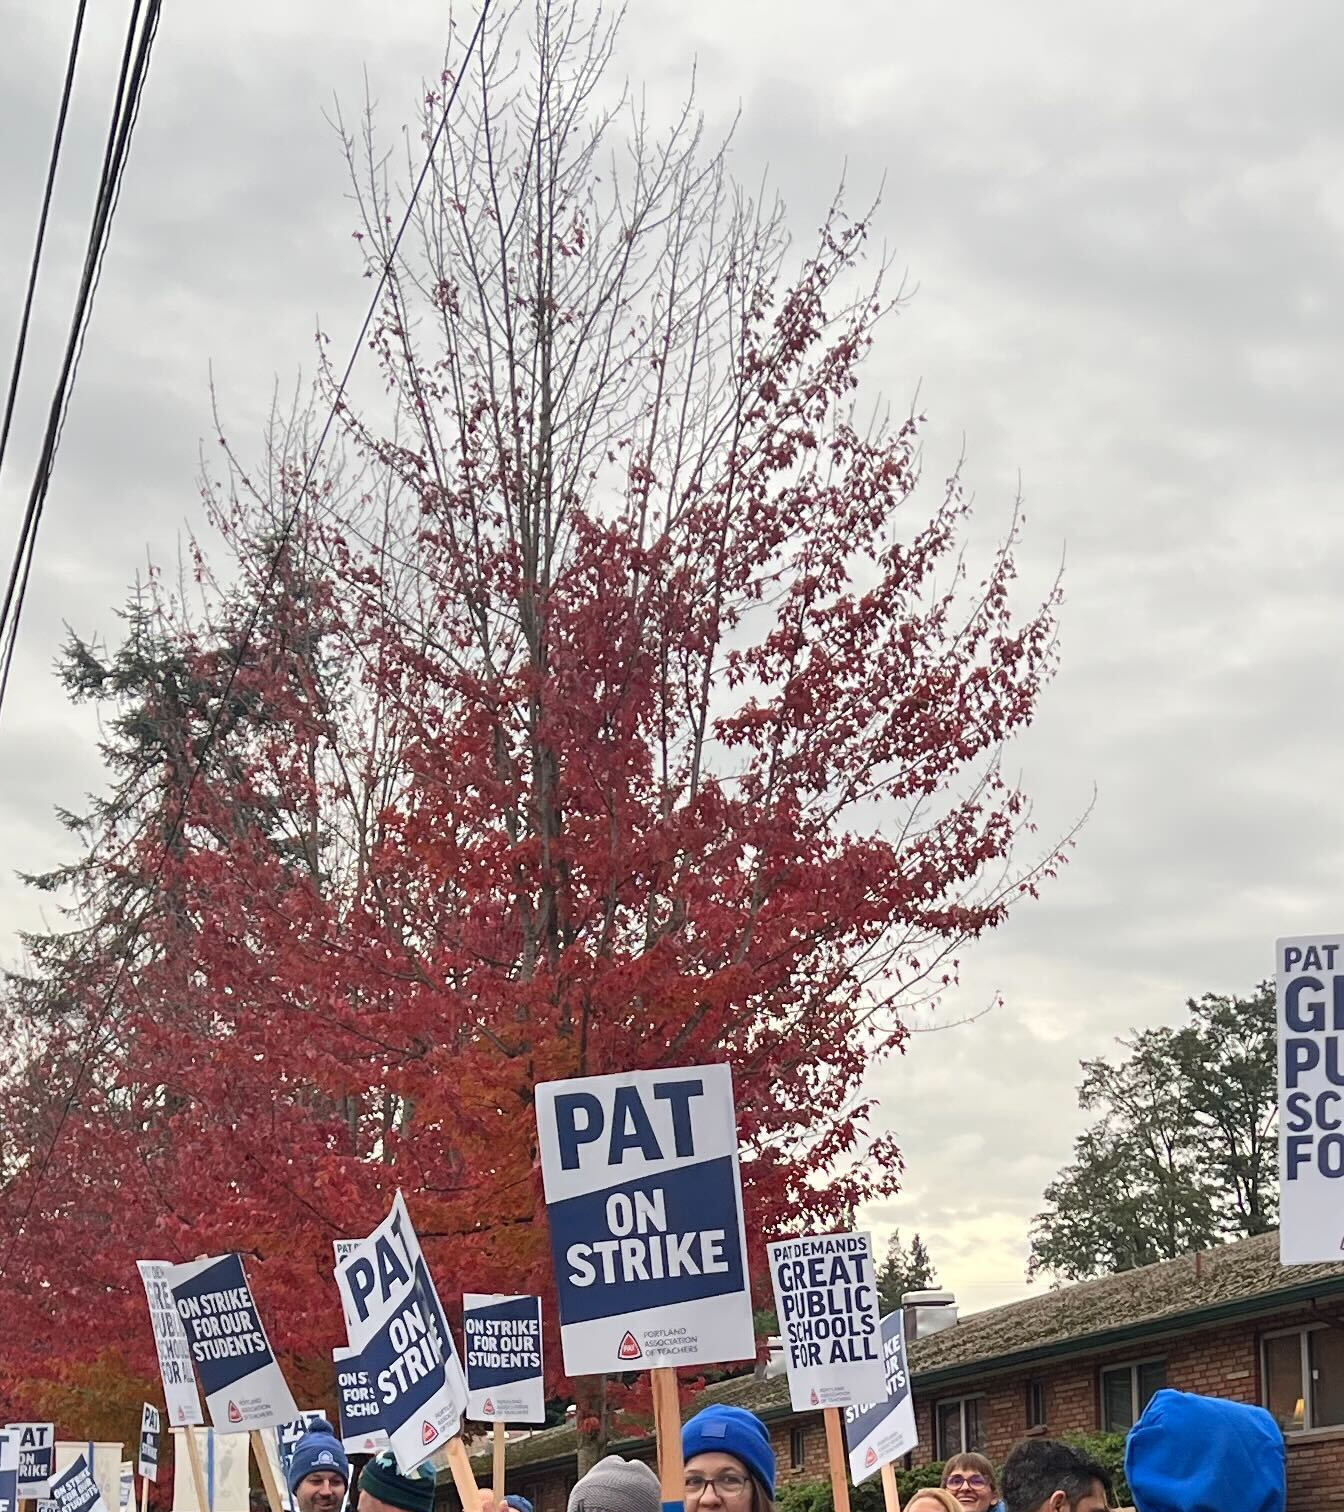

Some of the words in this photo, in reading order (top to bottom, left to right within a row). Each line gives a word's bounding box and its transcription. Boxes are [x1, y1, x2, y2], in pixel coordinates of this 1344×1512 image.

[1285, 944, 1339, 972] PAT
[554, 1079, 704, 1171] PAT
[606, 1188, 668, 1237] ON
[566, 1229, 729, 1287] STRIKE
[774, 1246, 794, 1262] PAT
[794, 1237, 867, 1258] DEMANDS
[345, 1209, 414, 1323] PAT
[777, 1253, 868, 1292] GREAT
[177, 1297, 201, 1319] ON
[200, 1287, 252, 1315] STRIKE
[781, 1285, 873, 1321] PUBLIC
[192, 1317, 222, 1340] FOR
[221, 1310, 254, 1334] OUR
[389, 1301, 426, 1353] ON
[466, 1319, 484, 1335] ON
[485, 1319, 539, 1336] STRIKE
[644, 1328, 687, 1338] PORTLAND
[787, 1314, 875, 1344] SCHOOLS
[193, 1332, 266, 1362] STUDENTS
[473, 1335, 498, 1351] FOR
[500, 1336, 534, 1352] OUR
[645, 1336, 697, 1347] ASSOCIATION
[790, 1342, 823, 1369] FOR
[829, 1337, 878, 1364] ALL
[468, 1352, 540, 1368] STUDENTS
[338, 1372, 357, 1387] ON
[342, 1388, 365, 1402] FOR
[345, 1402, 379, 1417] SCHO
[19, 1427, 48, 1446] AT
[19, 1464, 48, 1476] RIKE
